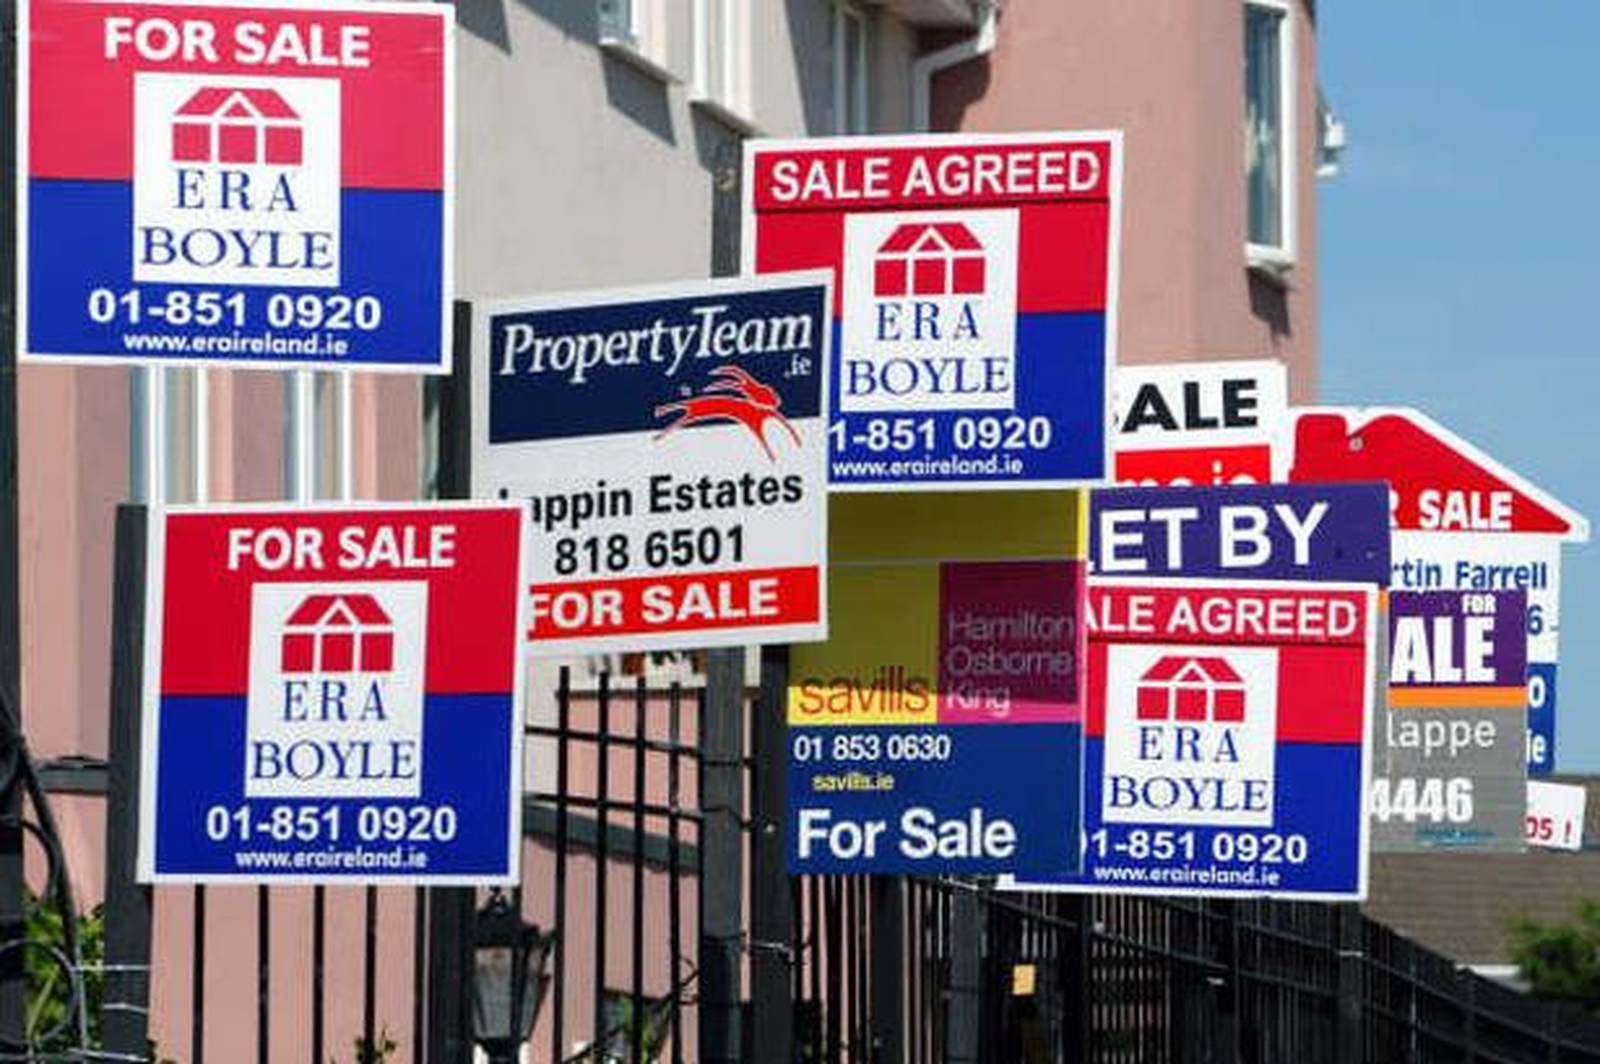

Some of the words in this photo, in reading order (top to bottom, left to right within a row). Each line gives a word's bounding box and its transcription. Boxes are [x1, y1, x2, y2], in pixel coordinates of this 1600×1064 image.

[104, 17, 219, 62] FOR
[235, 22, 370, 68] SALE
[174, 168, 298, 212] ERA
[771, 161, 891, 201] SALE
[903, 150, 1099, 197] AGREED
[138, 226, 334, 270] BOYLE
[88, 288, 247, 326] 01-851
[267, 295, 381, 331] 0920
[876, 302, 980, 341] ERA
[123, 331, 349, 356] www.eraireland.ie
[500, 306, 813, 384] PropertyTeam
[846, 357, 1010, 397] BOYLE
[1114, 378, 1258, 433] ALE
[829, 417, 936, 452] 1-851
[954, 416, 1051, 450] 0920
[832, 455, 1024, 478] www.eraireland.ie
[499, 480, 634, 533] ppin
[649, 473, 805, 514] Estates
[1419, 489, 1513, 530] SALE
[227, 526, 324, 572] FOR
[338, 525, 456, 570] SALE
[554, 533, 631, 576] 818
[644, 524, 745, 568] 6501
[1086, 506, 1199, 573] ET
[1219, 501, 1329, 569] BY
[1394, 559, 1442, 587] tin
[1455, 560, 1547, 590] Farrell
[529, 588, 624, 629] FOR
[641, 577, 780, 624] SALE
[1166, 597, 1358, 637] AGREED
[1462, 594, 1497, 614] FOR
[949, 609, 1074, 642] Hamilton
[946, 645, 1073, 678] Osborne
[1390, 616, 1497, 683] ALE
[284, 680, 388, 721] ERA
[799, 666, 930, 717] savills
[946, 682, 1011, 718] King
[251, 740, 416, 781] BOYLE
[794, 736, 823, 761] 01
[832, 736, 880, 761] 853
[887, 736, 952, 761] 0630
[1137, 726, 1239, 763] ERA
[813, 772, 895, 792] savills.ie
[1108, 775, 1270, 812] BOYLE
[206, 808, 340, 842] 01-851
[357, 806, 457, 840] 0920
[797, 810, 887, 859] For
[900, 807, 1017, 858] Sale
[235, 846, 428, 870] www.eraireland.ie
[1081, 829, 1197, 861] 1-851
[1211, 834, 1308, 864] 0920
[1094, 864, 1281, 886] www.eraireland.ie
